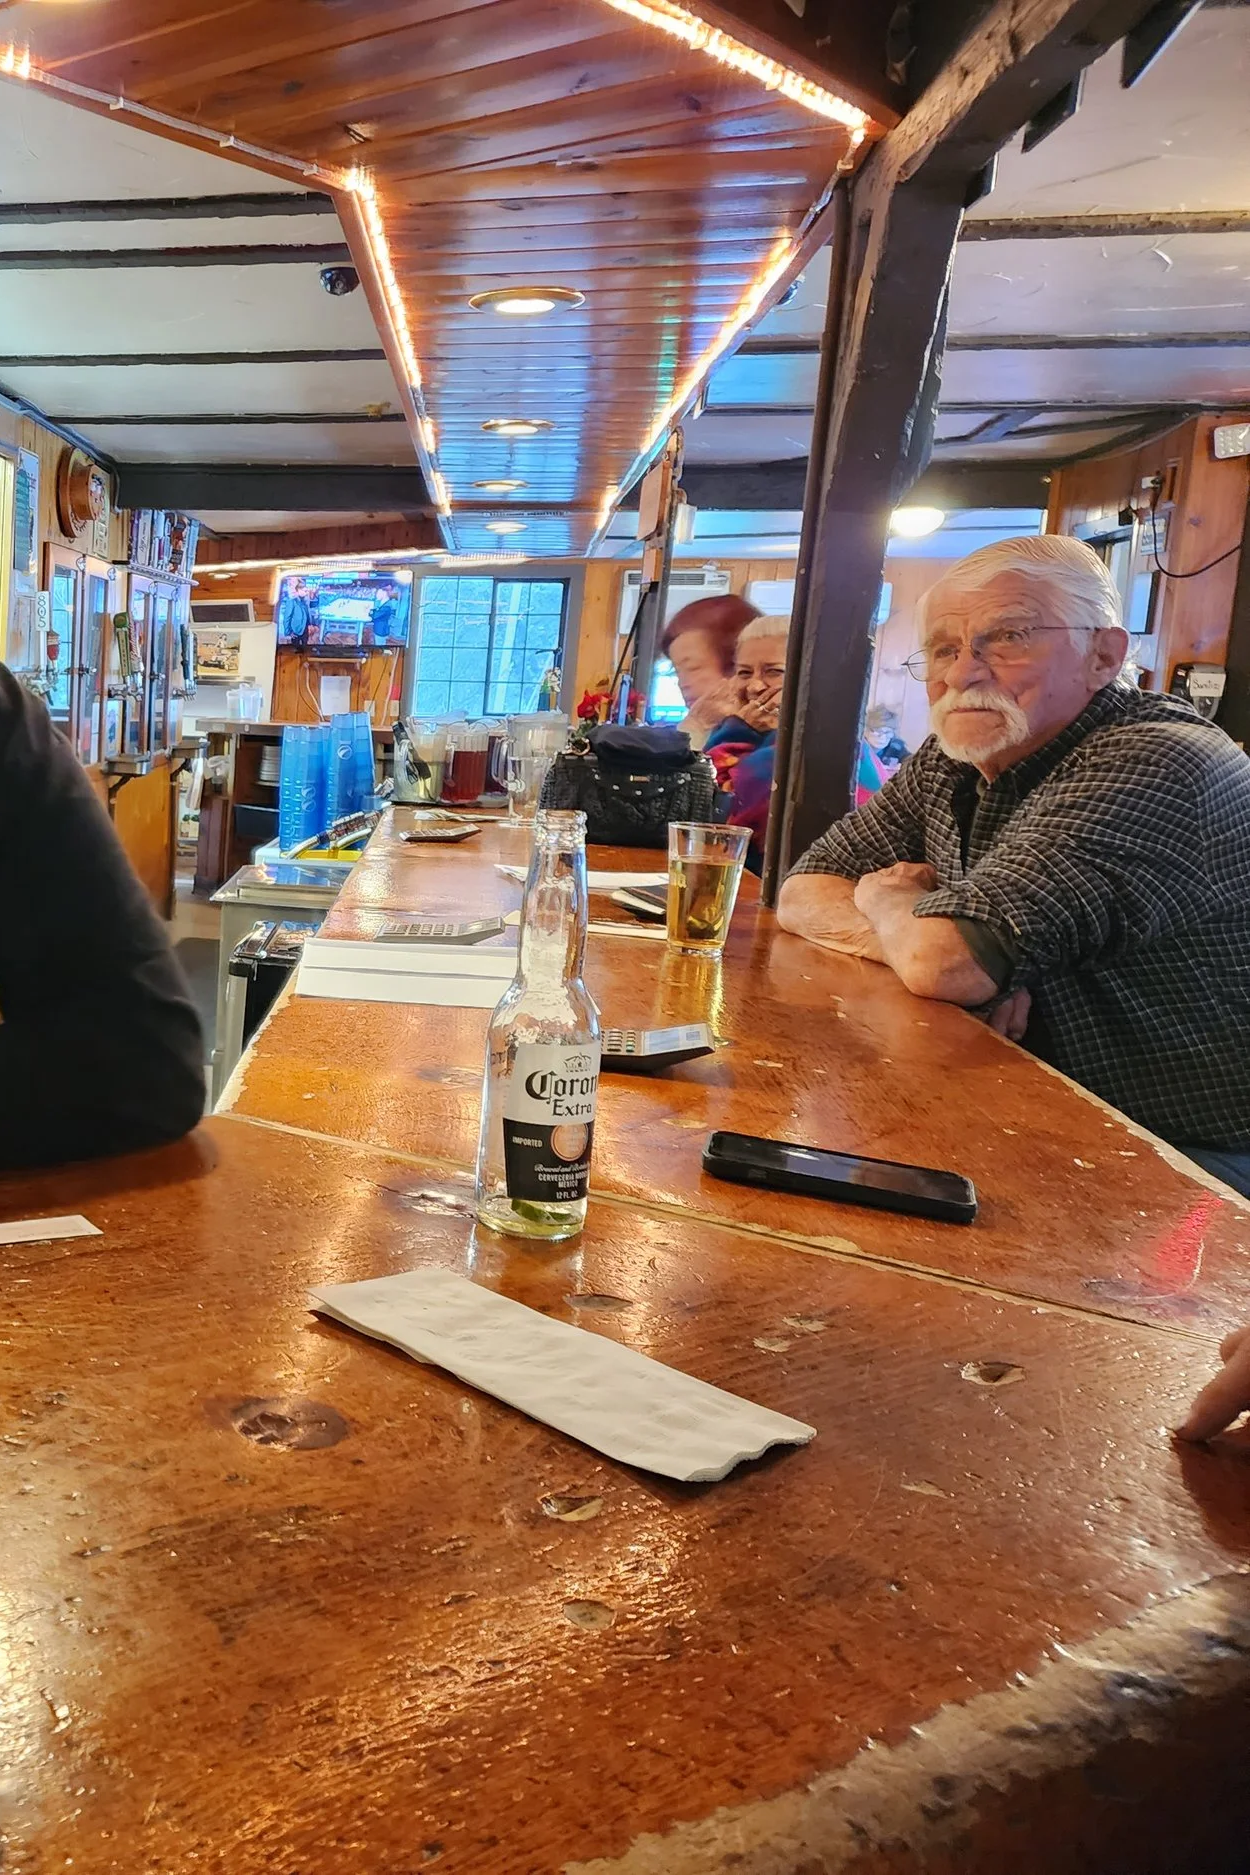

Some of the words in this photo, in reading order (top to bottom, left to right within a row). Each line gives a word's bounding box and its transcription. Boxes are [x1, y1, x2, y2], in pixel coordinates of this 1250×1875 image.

[525, 1070, 598, 1105] Coron
[552, 1099, 592, 1117] Extra
[512, 1136, 543, 1148] IMPORTED
